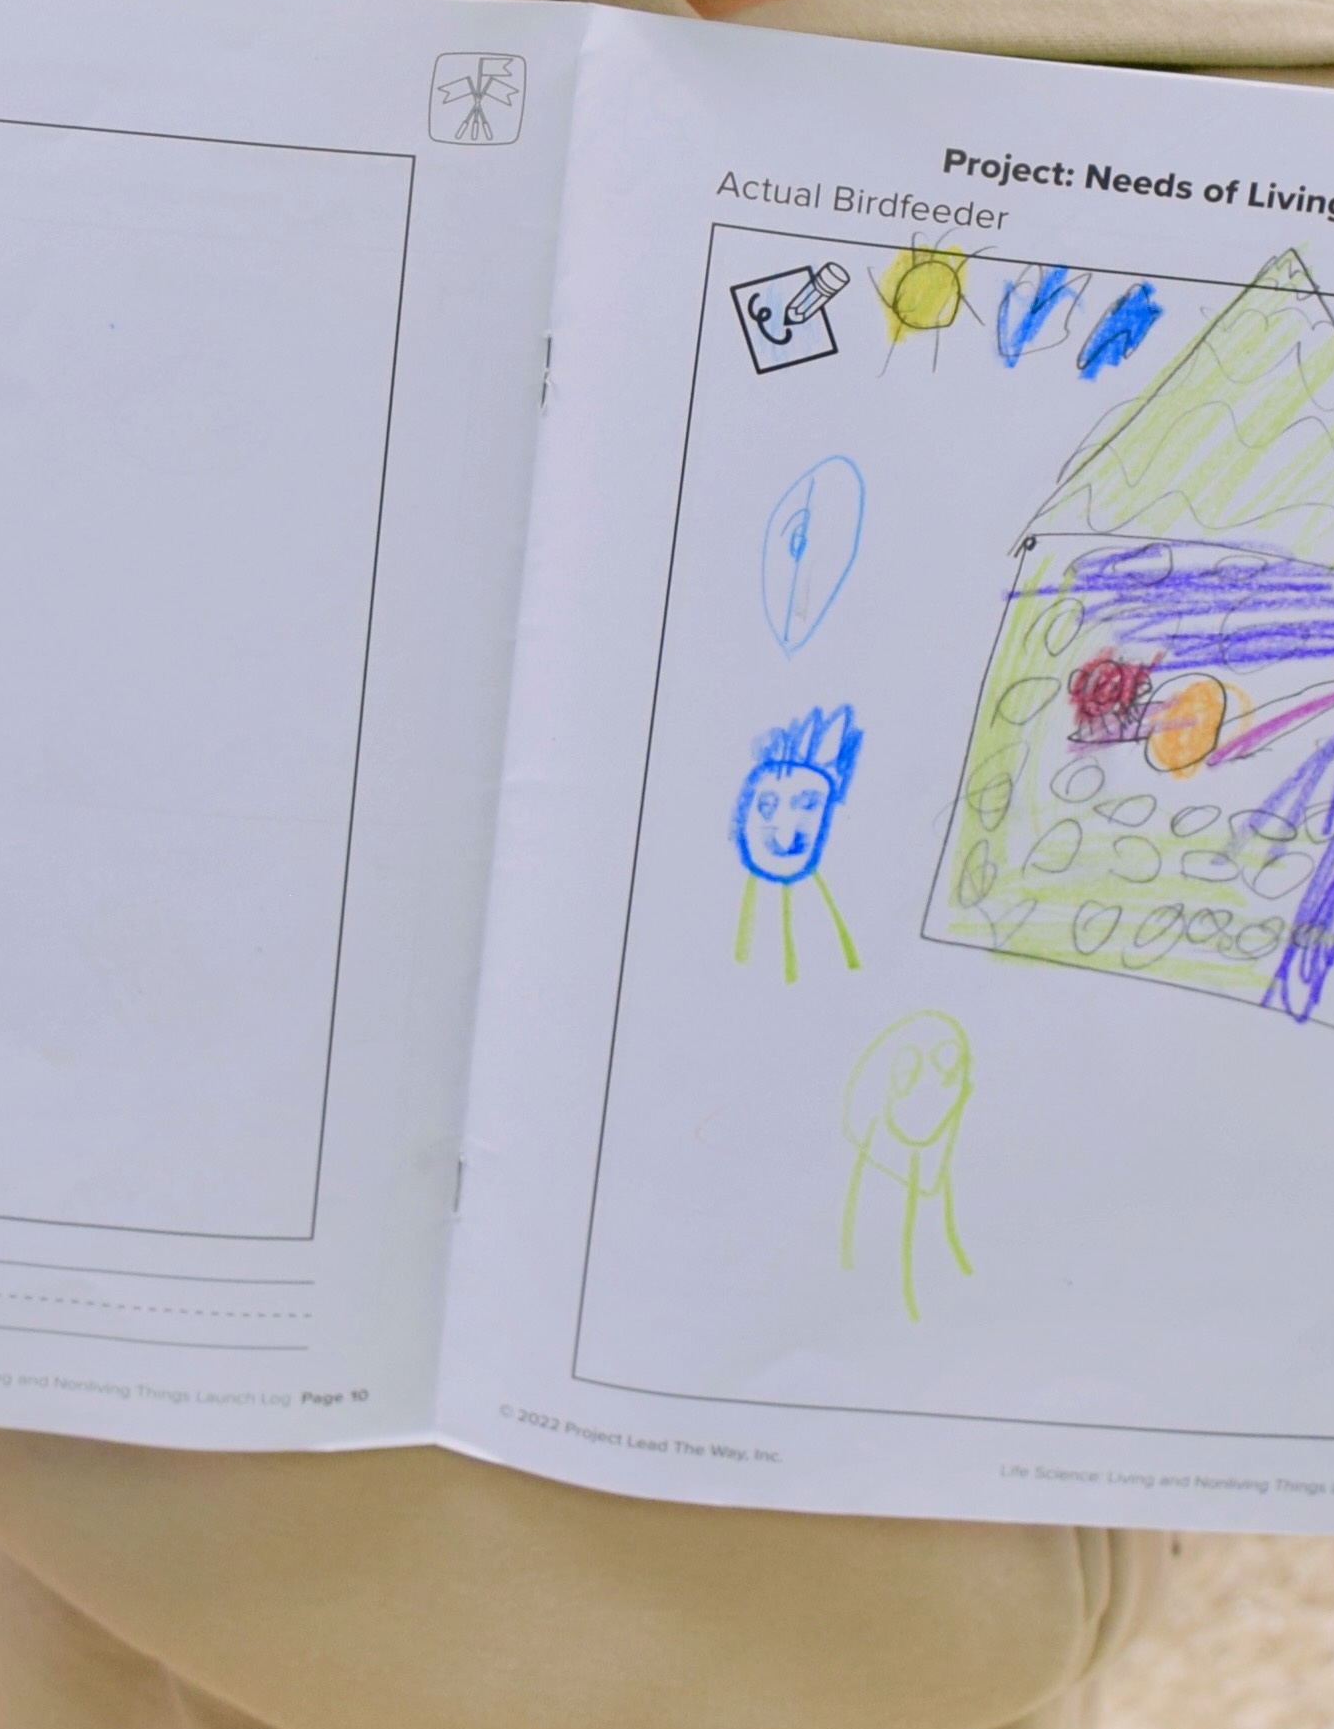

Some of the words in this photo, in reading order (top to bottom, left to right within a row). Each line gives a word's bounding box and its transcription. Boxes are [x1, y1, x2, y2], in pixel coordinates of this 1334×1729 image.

[943, 148, 1075, 187] Project:
[1085, 163, 1193, 200] Needs
[1203, 179, 1241, 205] of
[716, 171, 822, 209] Actual
[833, 185, 1010, 230] Birdfeeder
[17, 1373, 50, 1388] and
[53, 1376, 132, 1400] Nonliving
[136, 1383, 190, 1405] Things
[196, 1389, 256, 1406] Launch
[261, 1391, 292, 1407] Log
[301, 1390, 344, 1407] Page
[351, 1388, 370, 1403] 10
[565, 1421, 623, 1444] Project
[627, 1435, 668, 1453] Lead
[674, 1440, 706, 1456] The
[709, 1444, 750, 1463] Way,
[753, 1448, 784, 1463] Inc.
[1000, 1464, 1030, 1478] Life
[1107, 1471, 1155, 1489] Living
[1159, 1475, 1191, 1488] and
[1195, 1475, 1270, 1495] Nonliving
[1275, 1478, 1327, 1497] Things
